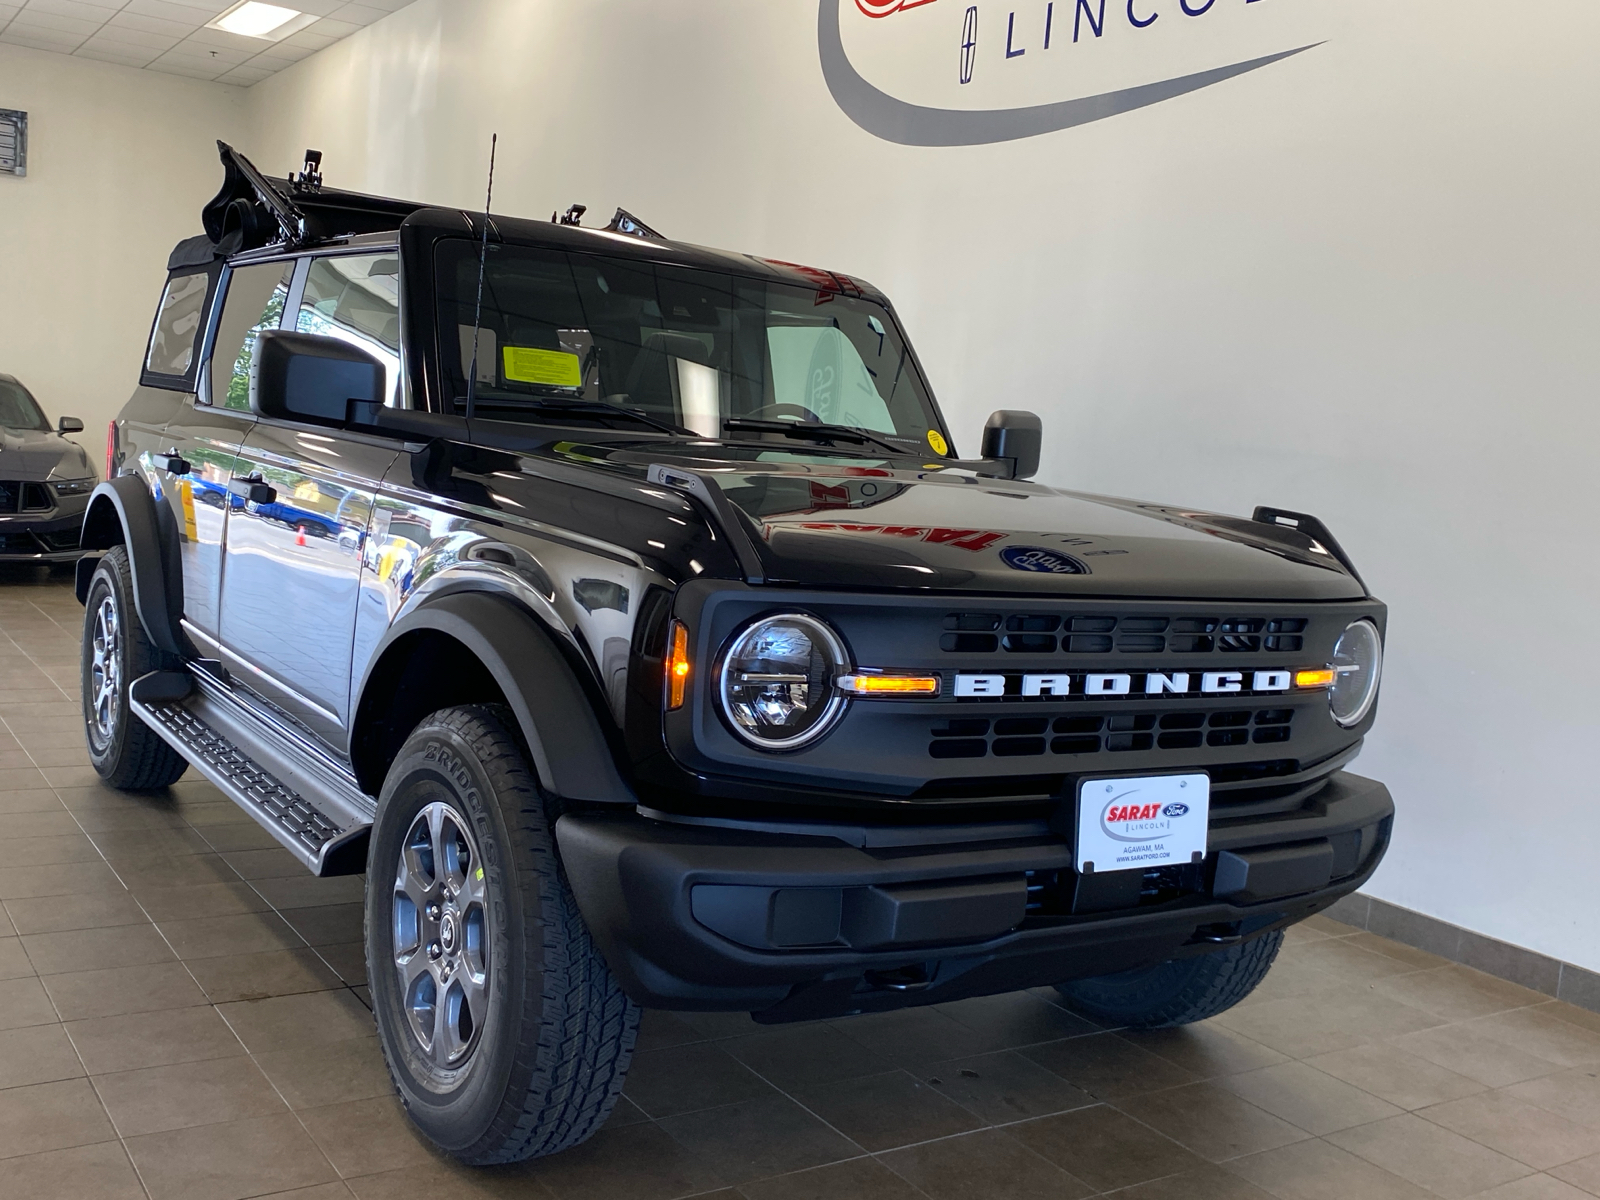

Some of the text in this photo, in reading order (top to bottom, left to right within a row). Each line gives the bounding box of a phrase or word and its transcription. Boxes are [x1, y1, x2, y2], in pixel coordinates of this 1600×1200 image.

[1005, 0, 1265, 59] LINC
[953, 670, 1292, 698] BRONCO
[1106, 802, 1162, 823] SARAT
[1131, 821, 1165, 831] LINCOLN
[1123, 843, 1164, 854] AGAWAM, MA
[1116, 852, 1170, 862] WWW.SARATFORD.COM
